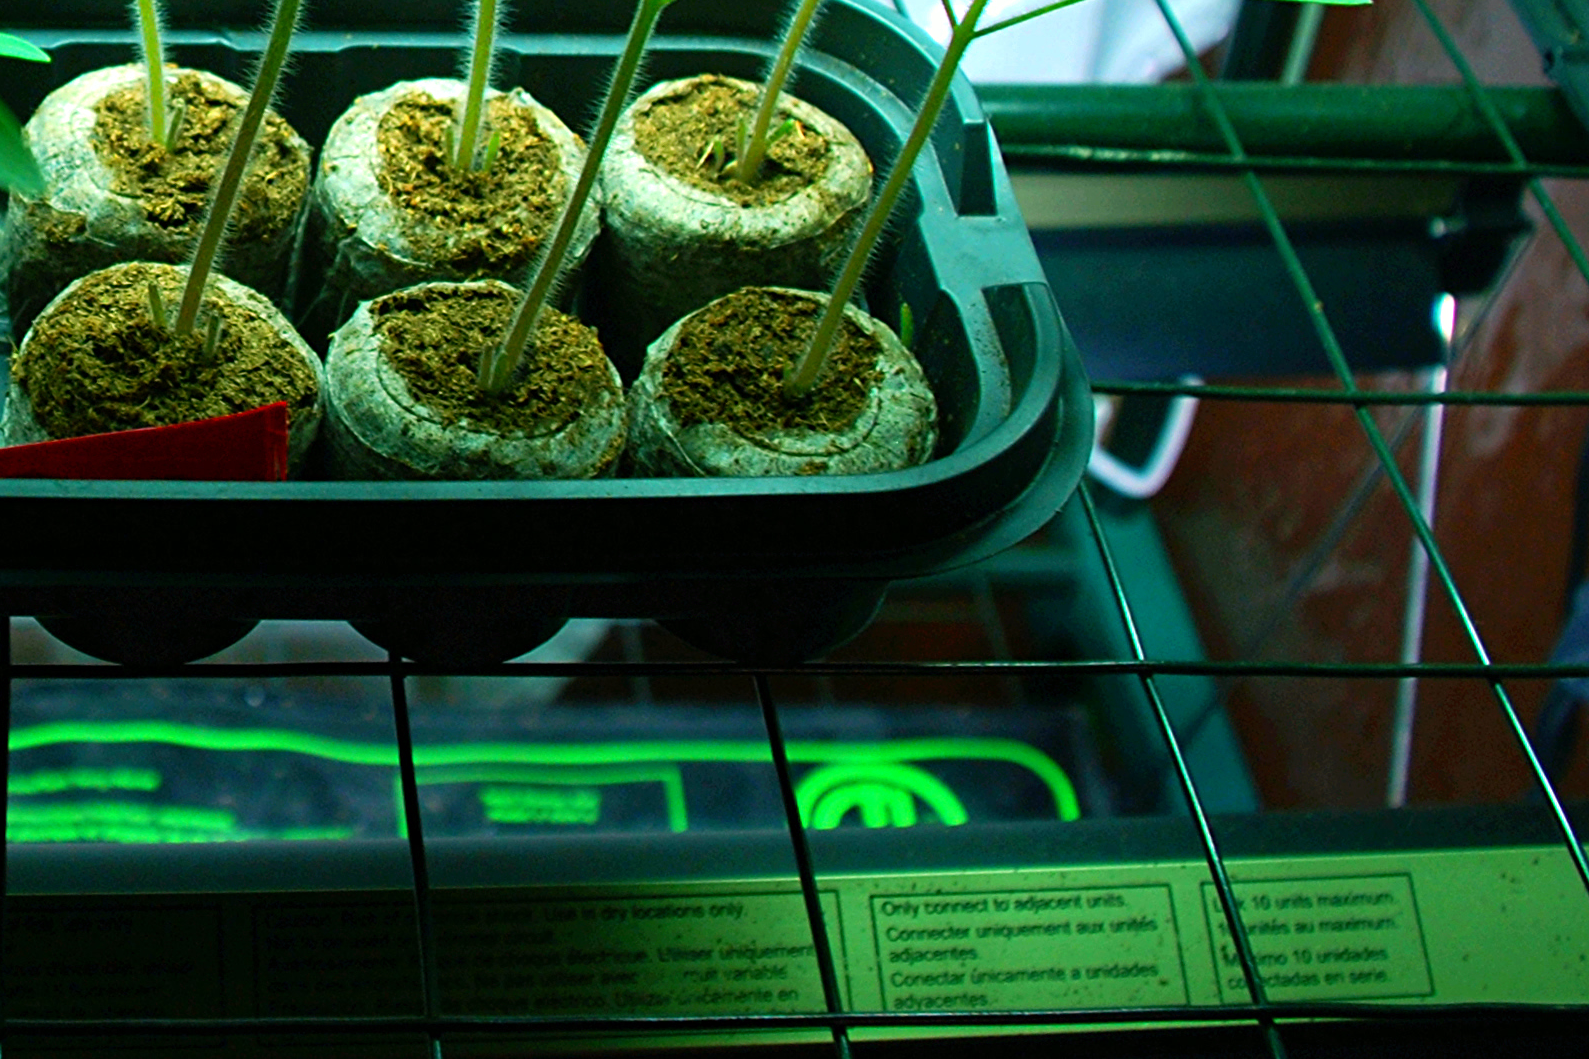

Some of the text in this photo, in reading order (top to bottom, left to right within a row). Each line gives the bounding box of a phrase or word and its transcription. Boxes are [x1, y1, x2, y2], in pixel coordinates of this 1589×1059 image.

[880, 900, 920, 920] Only
[923, 898, 988, 915] connect
[992, 897, 1011, 913] to
[1013, 894, 1081, 915] adjacent
[1251, 894, 1271, 912] 10
[1274, 893, 1313, 910] units
[885, 913, 1158, 943] Connecter uniquement aux unités
[1294, 921, 1315, 934] au
[1292, 948, 1312, 965] 10
[1316, 945, 1389, 964] unidades
[889, 971, 964, 988] Conectar
[1069, 968, 1081, 980] a
[1085, 962, 1158, 981] unidades
[1323, 971, 1345, 986] en
